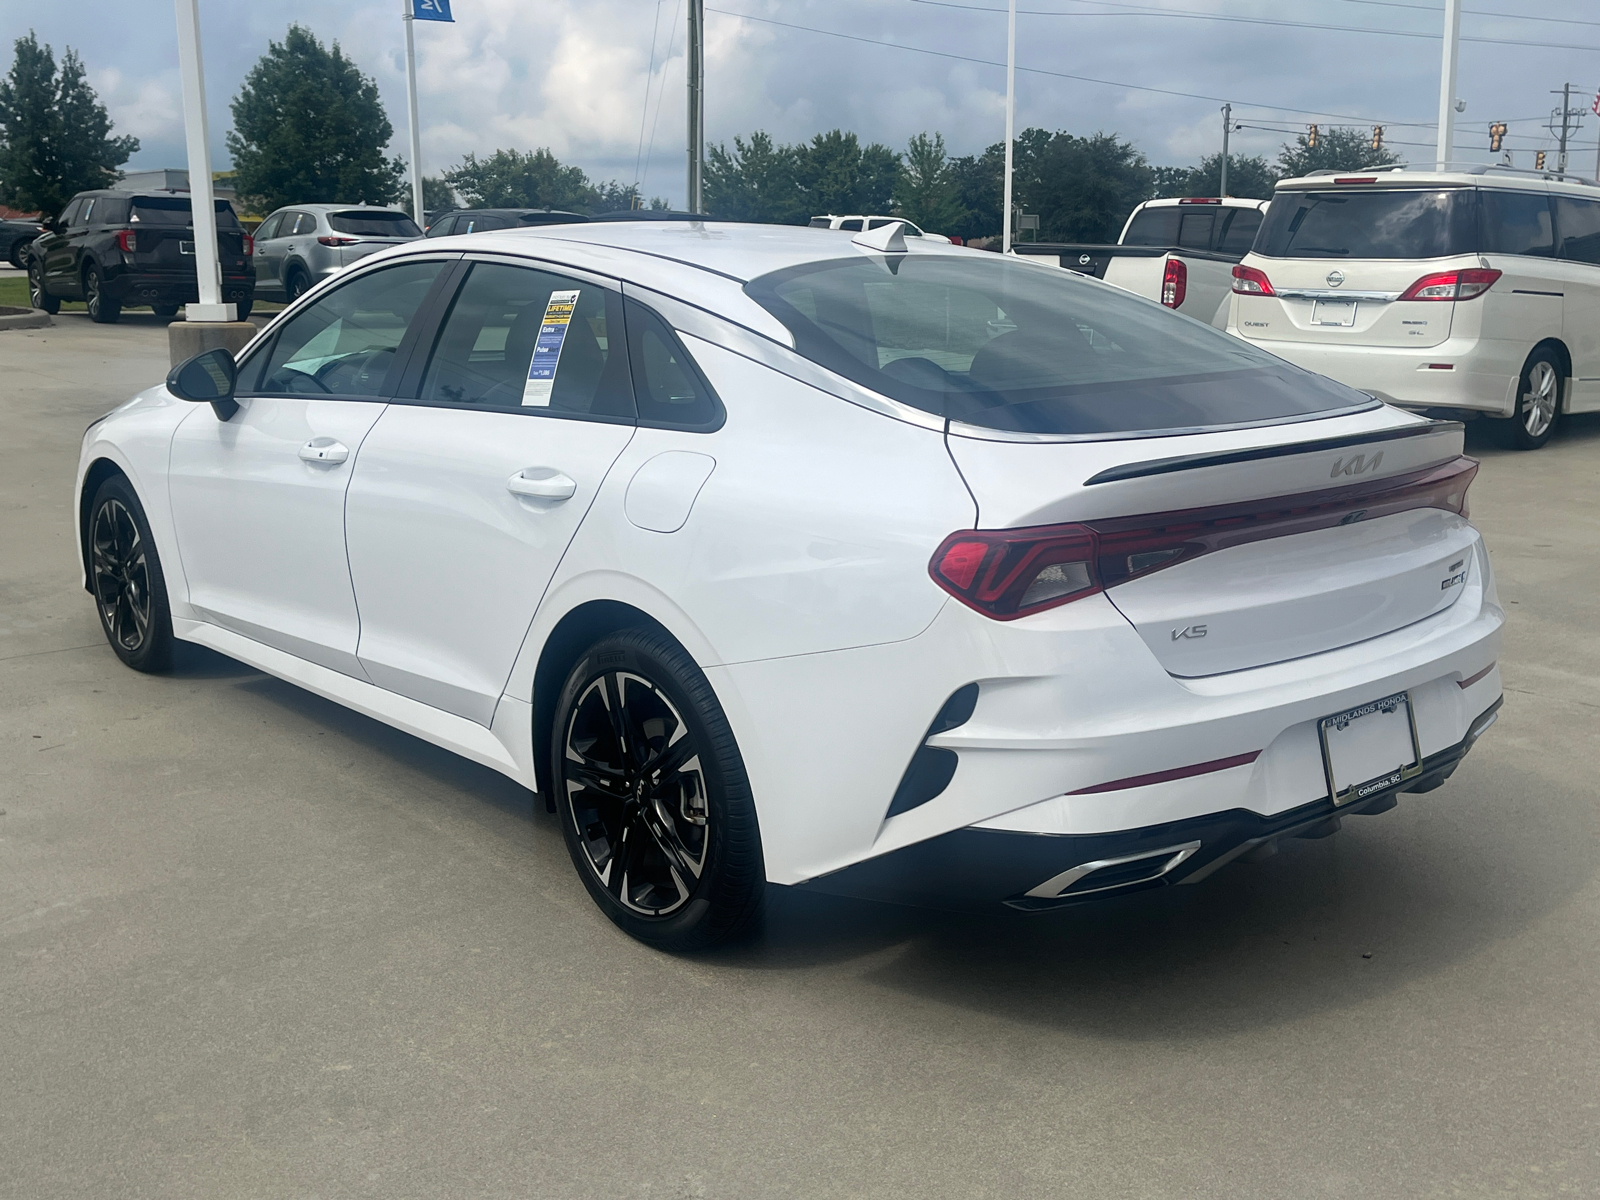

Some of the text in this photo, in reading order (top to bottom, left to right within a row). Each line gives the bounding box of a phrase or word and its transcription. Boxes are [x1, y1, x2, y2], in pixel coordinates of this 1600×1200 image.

[547, 304, 574, 312] LIFETIME
[1330, 450, 1384, 478] KIA
[1171, 624, 1207, 641] K5
[597, 650, 625, 665] PIRELLI
[1332, 694, 1407, 725] MIDLANDS HONDA
[1358, 774, 1401, 796] Columbia, SC
